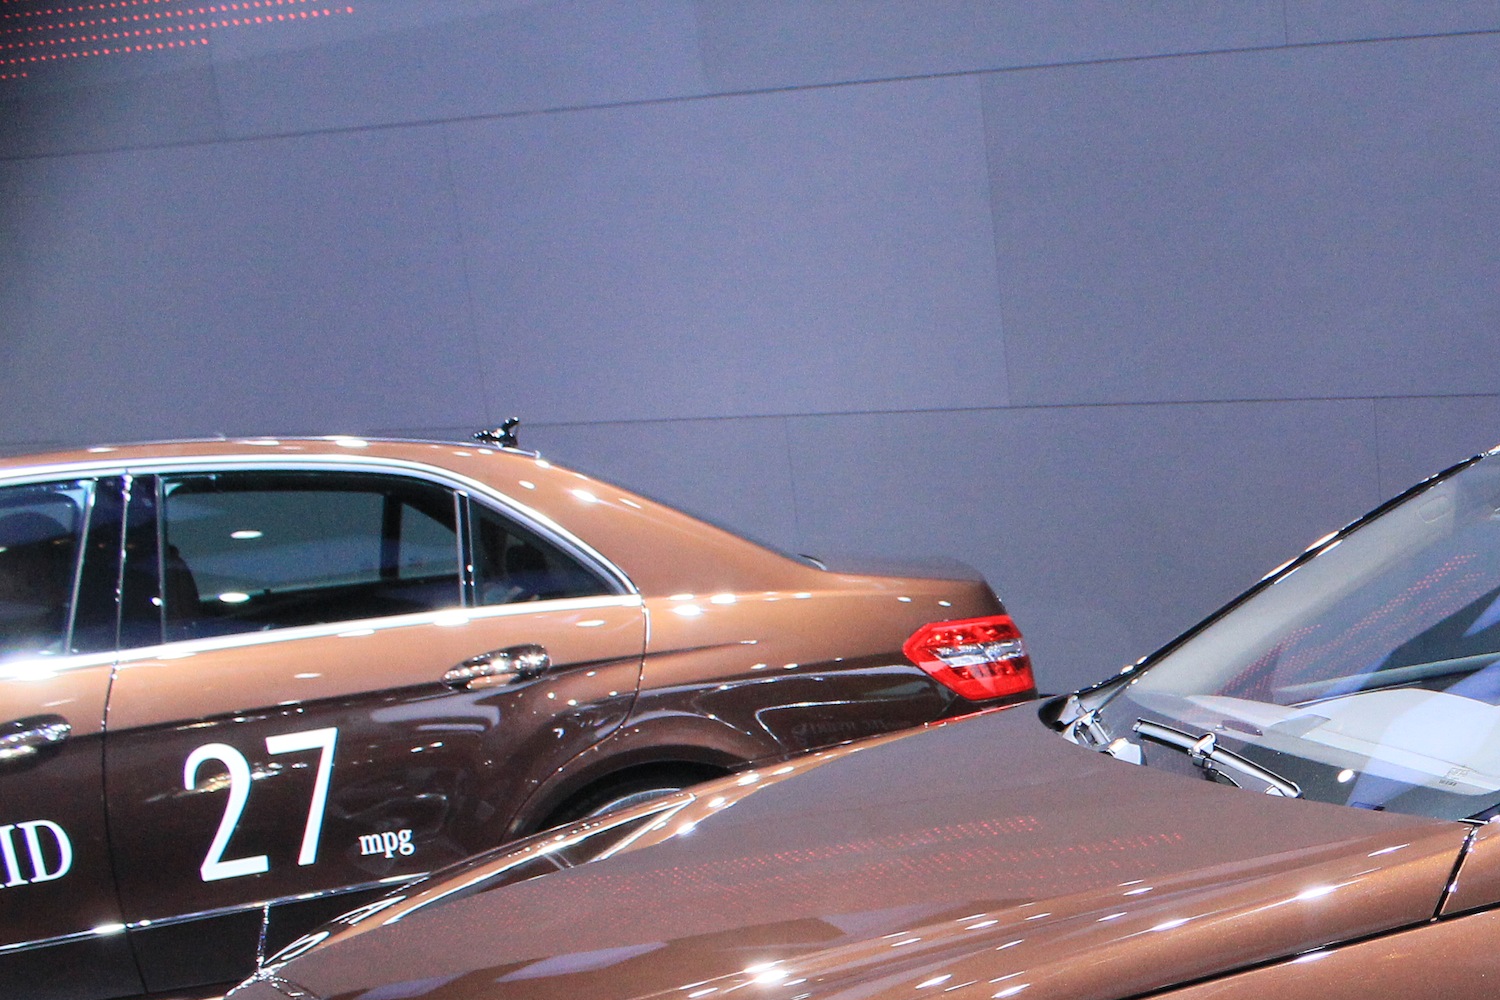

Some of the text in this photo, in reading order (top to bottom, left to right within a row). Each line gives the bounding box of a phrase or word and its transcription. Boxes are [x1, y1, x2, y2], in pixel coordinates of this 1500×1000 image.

[0, 819, 73, 889] ID
[183, 726, 415, 882] 27 mpg
